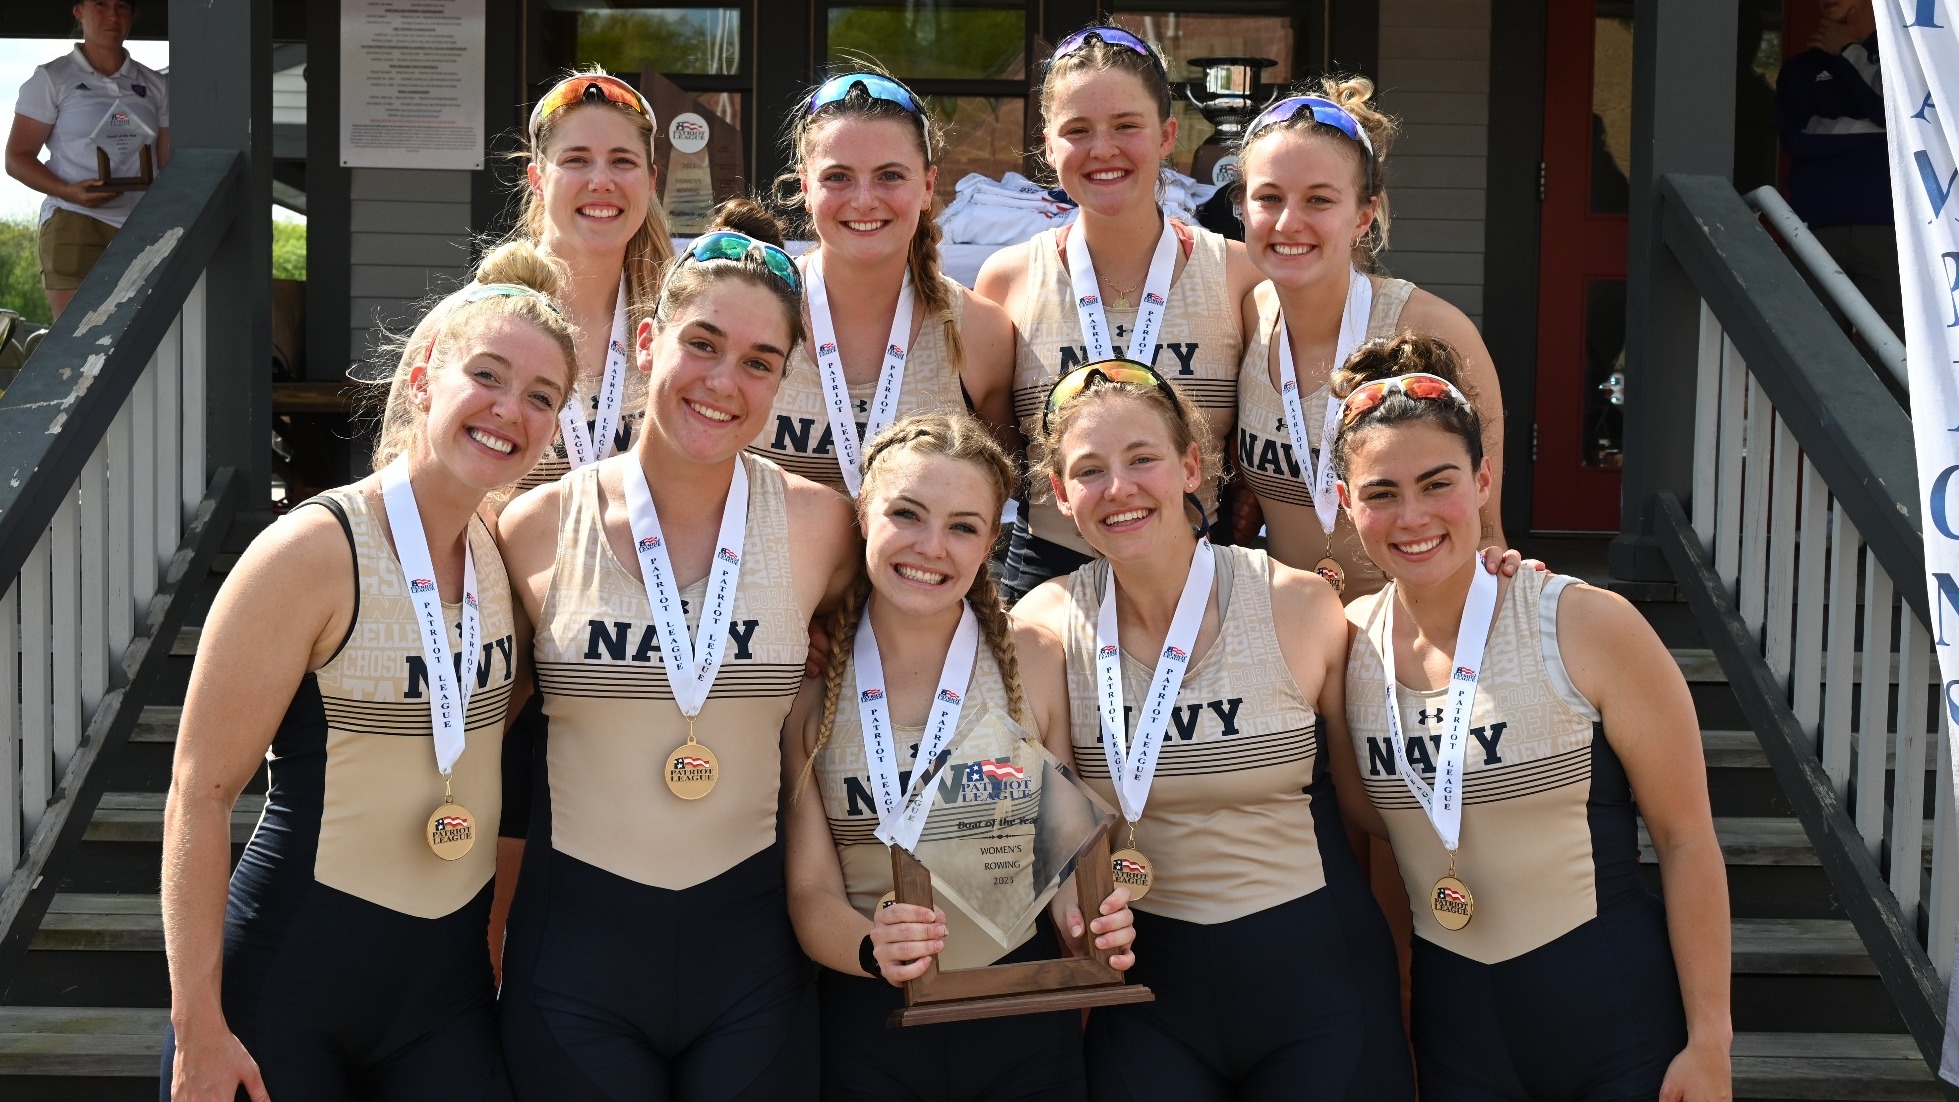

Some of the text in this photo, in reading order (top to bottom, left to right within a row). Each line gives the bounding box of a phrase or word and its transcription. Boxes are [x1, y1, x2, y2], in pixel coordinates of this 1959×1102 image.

[1088, 312, 1102, 356] PATRIOT
[1138, 311, 1154, 355] PATRIOT
[606, 360, 618, 410] PATRIOT
[879, 364, 896, 414] PATRIOT
[828, 362, 856, 465] PATRIOT LEAGUE
[570, 419, 586, 463] LEAGUE
[1240, 427, 1321, 479] NAV
[650, 558, 684, 671] PATRIOT LEAGUE
[697, 570, 729, 682] PATRIOT LEAGUE
[583, 619, 759, 663] NAY
[404, 634, 513, 699] NVY
[424, 602, 452, 728] PATRIOT LEAGUE
[1106, 666, 1117, 723] PATRIOT
[927, 710, 948, 765] PATRIOT
[1134, 668, 1174, 781] PATRIOT LEAGUE
[670, 768, 714, 776] PATRIOT
[871, 709, 885, 763] PATRIOT
[880, 773, 894, 814] LEAGU
[1443, 690, 1465, 810] PATRIOT LEAGUE
[671, 774, 714, 782] LEAGUE
[961, 779, 1032, 793] PATRIOT
[962, 789, 1033, 803] LEAGUE
[432, 827, 471, 838] PATRIOT
[433, 833, 472, 844] LEAGUE
[957, 815, 1040, 830] Boat of the Year
[980, 844, 1022, 856] WOMEN'S
[984, 860, 1021, 871] ROWING
[993, 875, 1014, 886] 2023
[1113, 871, 1148, 880] ATRIOT
[1114, 876, 1148, 886] EAGUE
[1434, 897, 1469, 909] PATRIOT
[1434, 903, 1469, 916] LEAGUE
